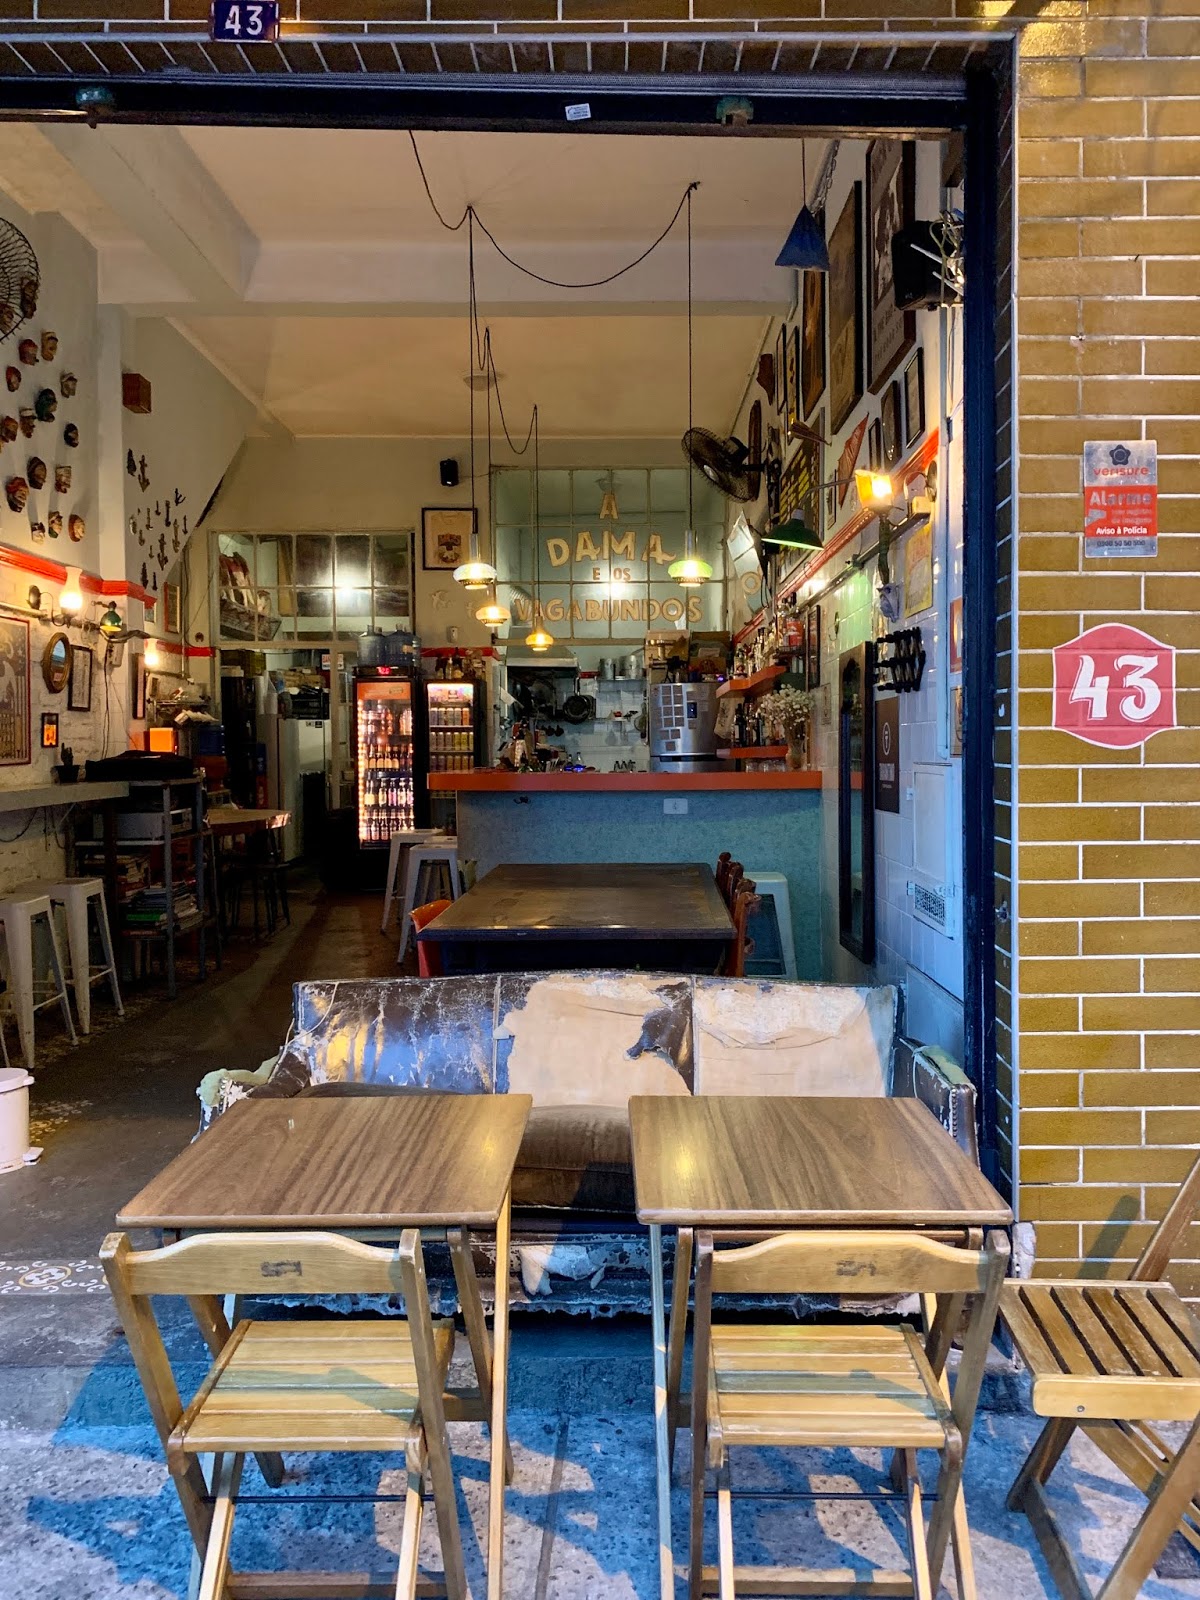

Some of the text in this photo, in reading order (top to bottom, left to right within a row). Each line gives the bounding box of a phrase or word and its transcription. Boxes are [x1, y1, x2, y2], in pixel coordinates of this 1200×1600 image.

[225, 5, 263, 35] 43
[1093, 467, 1149, 476] verisure
[600, 493, 619, 520] A
[1096, 527, 1115, 535] Aviso
[1123, 526, 1147, 535] Polícia
[546, 530, 677, 567] DAMA
[592, 567, 631, 582] E OS
[514, 595, 704, 624] VAGABUNDOS
[1068, 654, 1162, 723] 43
